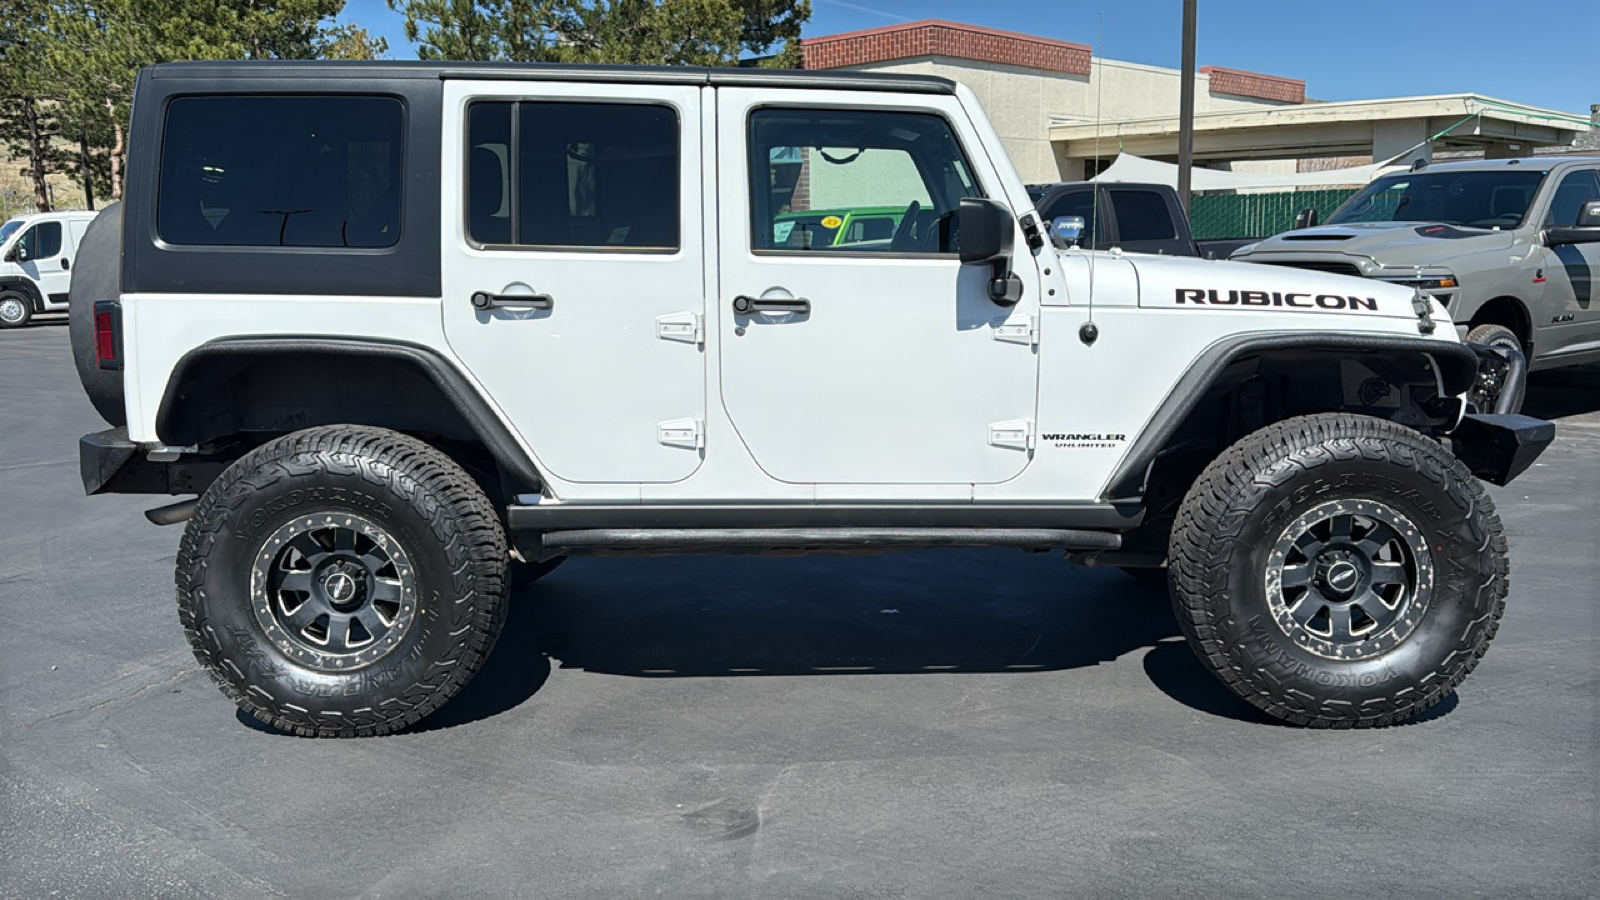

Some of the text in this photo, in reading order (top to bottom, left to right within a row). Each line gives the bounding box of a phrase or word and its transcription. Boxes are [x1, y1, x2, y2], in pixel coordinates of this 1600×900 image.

[1175, 288, 1379, 311] RUBICON
[1551, 314, 1575, 324] RAM
[1041, 433, 1126, 441] WRANGLER
[235, 487, 394, 542] YOKOHAMA
[1249, 614, 1402, 687] YOKOHAMA
